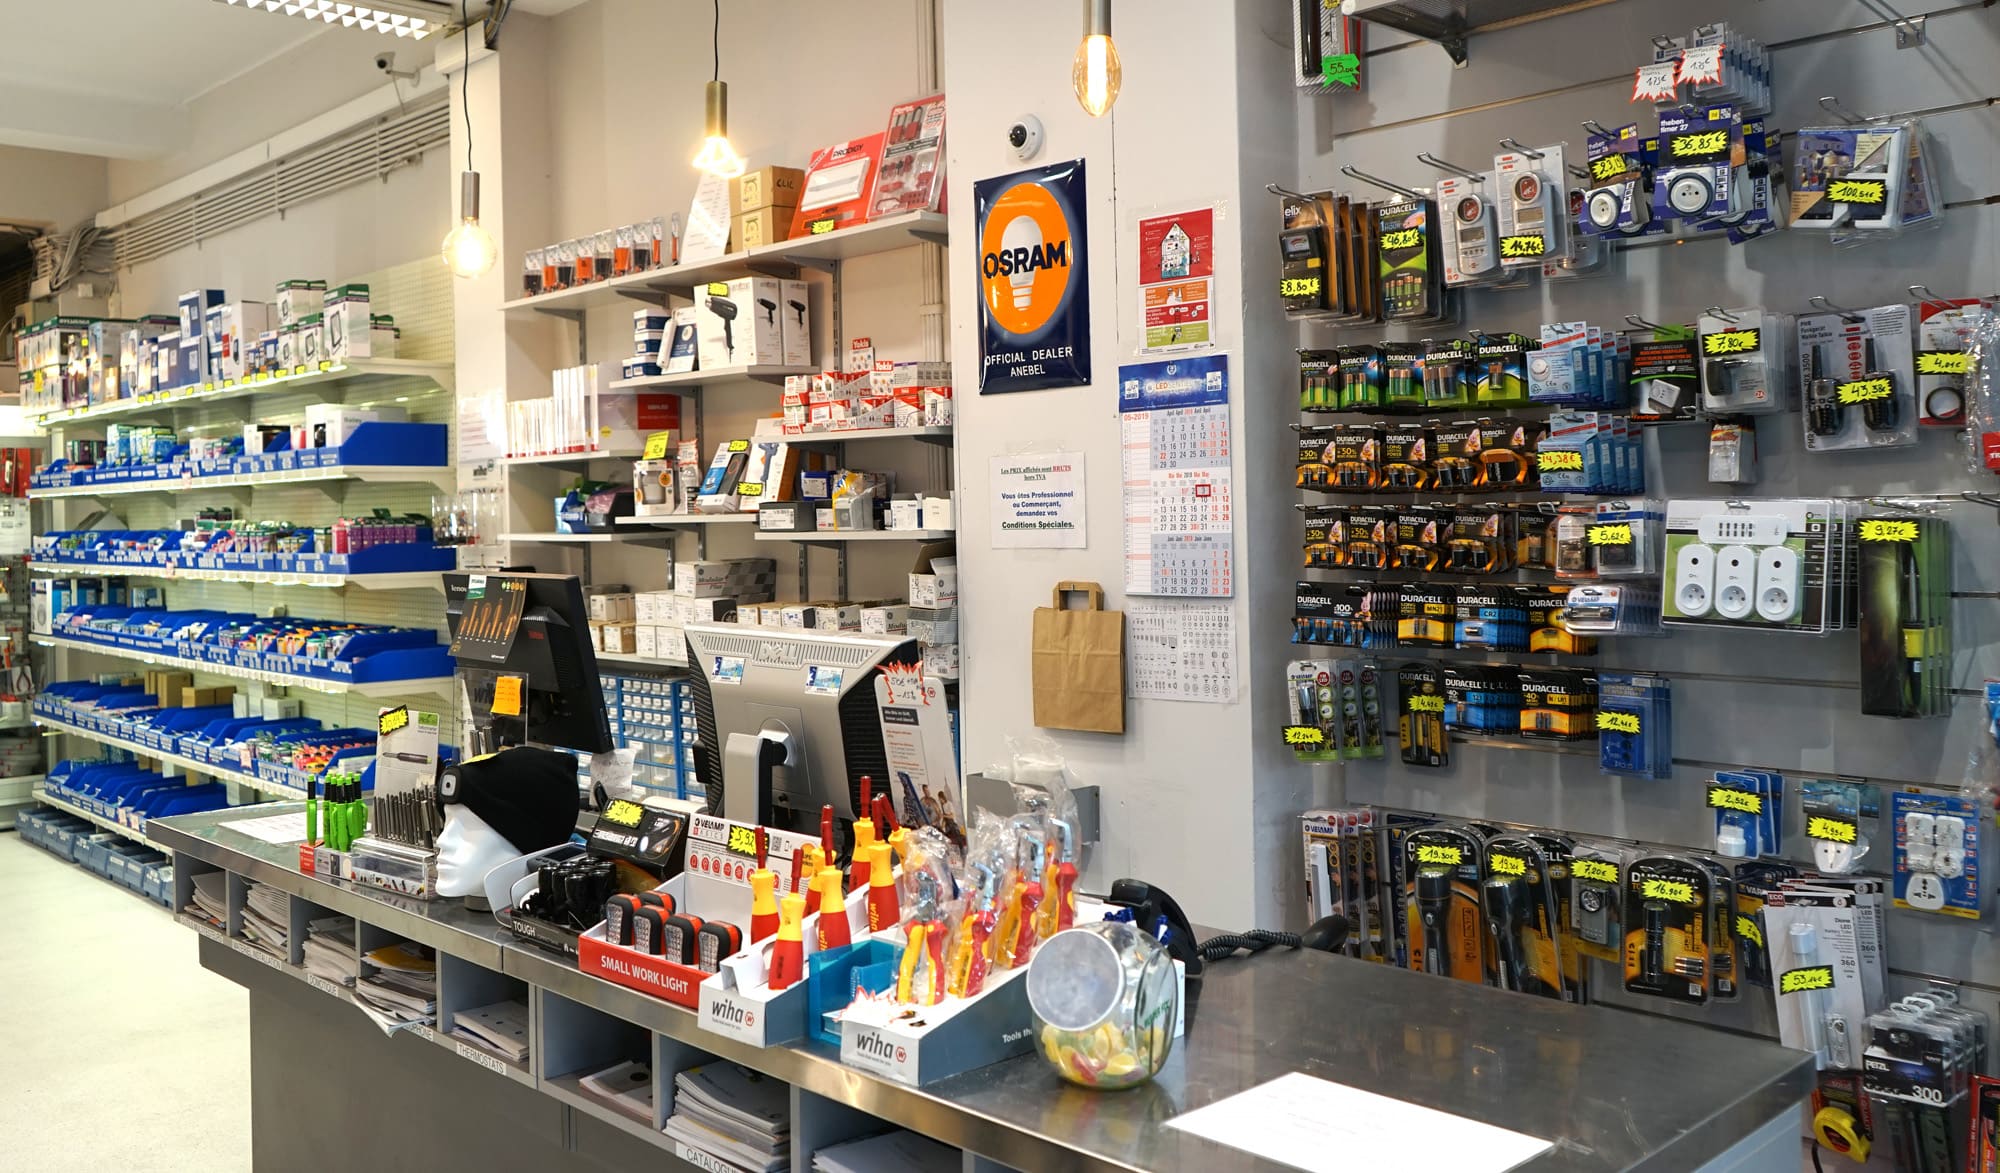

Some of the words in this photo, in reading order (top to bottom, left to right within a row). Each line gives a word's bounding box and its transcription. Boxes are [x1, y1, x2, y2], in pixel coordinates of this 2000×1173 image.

[1380, 203, 1418, 217] DURACELL
[983, 240, 1067, 279] OSRAM
[1479, 343, 1518, 355] DURACELL
[985, 351, 1026, 367] OFFICIAL
[1032, 345, 1073, 360] DEALER
[1387, 353, 1416, 363] DURACELL
[1426, 349, 1463, 361] DURACELL
[1301, 360, 1329, 370] DURACELL
[1340, 356, 1368, 366] DURACELL
[1010, 363, 1046, 378] ANEBEL
[1437, 433, 1468, 443] DURACELL
[1482, 429, 1506, 437] DURACELL
[1300, 437, 1328, 447] DURACELL
[1336, 434, 1366, 444] DURACELL
[1386, 434, 1416, 443] DURACELL
[1031, 490, 1074, 499] Professionnel
[1021, 501, 1062, 509] Commerçant,
[1305, 518, 1333, 526] DURACELL
[1350, 516, 1376, 524] DURACELL
[1398, 515, 1428, 524] DURACELL
[1455, 515, 1482, 524] DURACELL
[1002, 521, 1036, 529] Conditions
[1038, 520, 1075, 530] Spéciales.
[1297, 596, 1332, 605] DURACELL
[1400, 594, 1442, 603] DURACELL
[1456, 596, 1496, 605] DURACELL
[1400, 672, 1436, 682] DURACELL
[1445, 679, 1481, 689] DURACELL
[1522, 684, 1566, 694] DURACELL
[700, 818, 725, 832] VELAMP
[1310, 825, 1334, 836] VELAMP
[1745, 884, 1763, 895] VAR
[1768, 893, 1784, 902] ECO
[869, 903, 881, 931] wiha
[513, 920, 536, 937] TOUGH
[1841, 959, 1856, 967] 360
[601, 955, 631, 977] SMALL
[632, 964, 660, 987] WORK
[661, 974, 689, 996] LIGHT
[309, 974, 337, 996] DOMOTIQUE
[712, 999, 743, 1024] wiha
[1002, 1031, 1022, 1043] Tools
[857, 1032, 894, 1060] wiha
[458, 1043, 505, 1074] THERMOSTATS
[1912, 1084, 1943, 1104] 300
